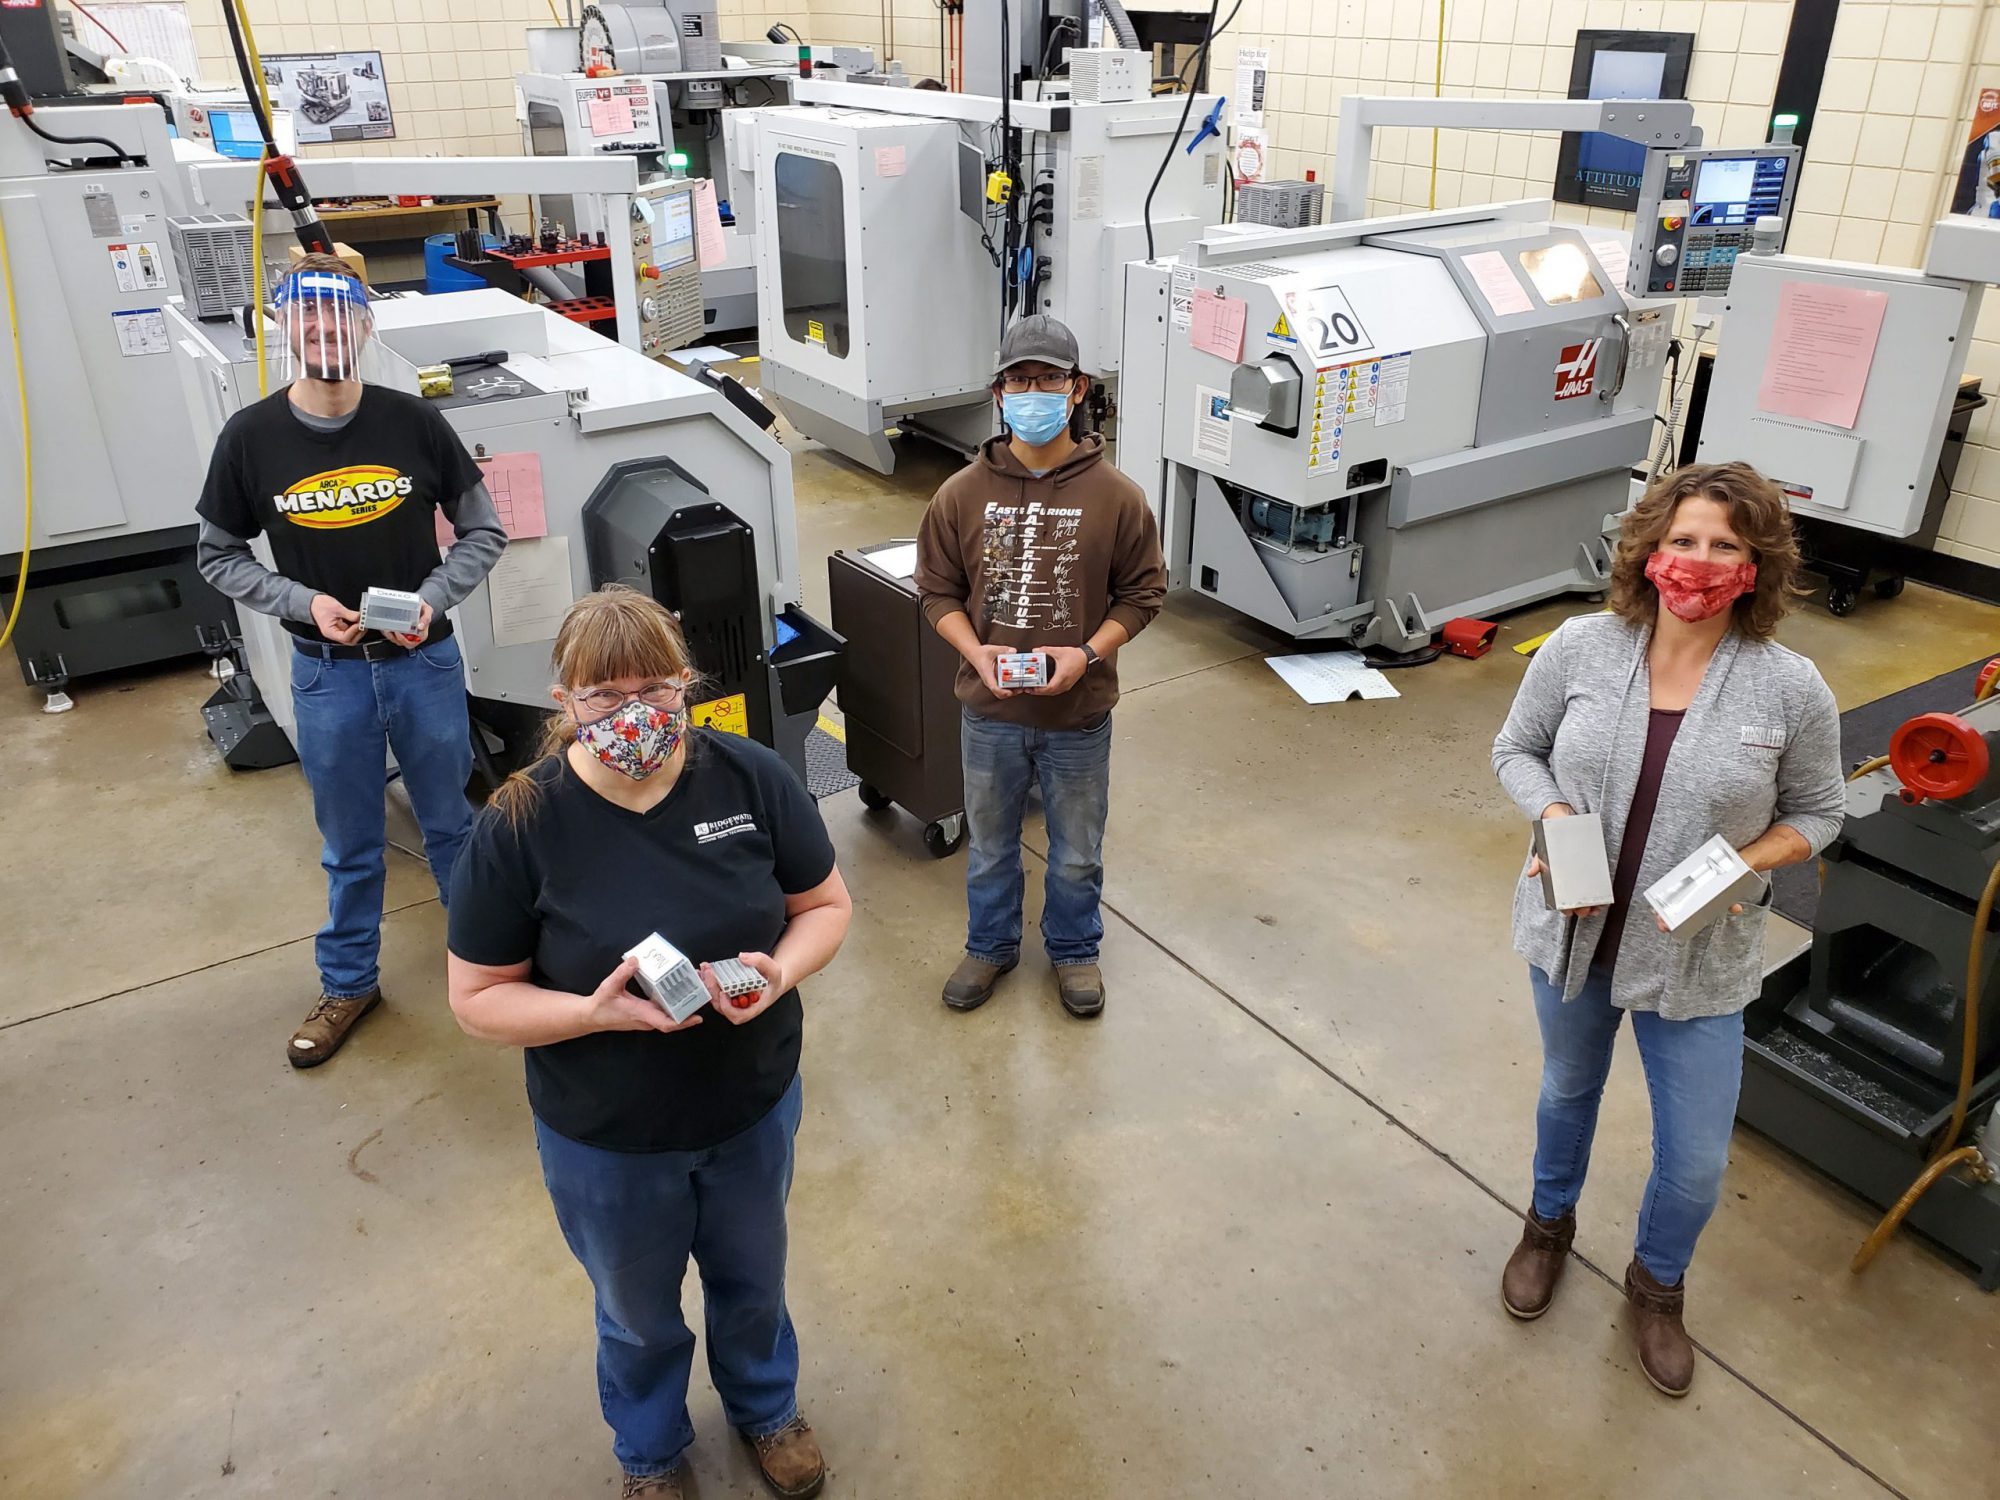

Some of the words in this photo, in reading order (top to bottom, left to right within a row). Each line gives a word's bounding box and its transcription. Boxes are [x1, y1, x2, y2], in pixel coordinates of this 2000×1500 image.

[577, 90, 596, 99] SUPER
[1307, 312, 1359, 350] 20
[1555, 378, 1593, 398] HAAS
[320, 479, 338, 489] ARCA
[273, 477, 412, 513] MENARDS
[351, 504, 377, 516] SERIES
[984, 502, 1018, 515] FAST
[1026, 502, 1083, 516] FURIOUS
